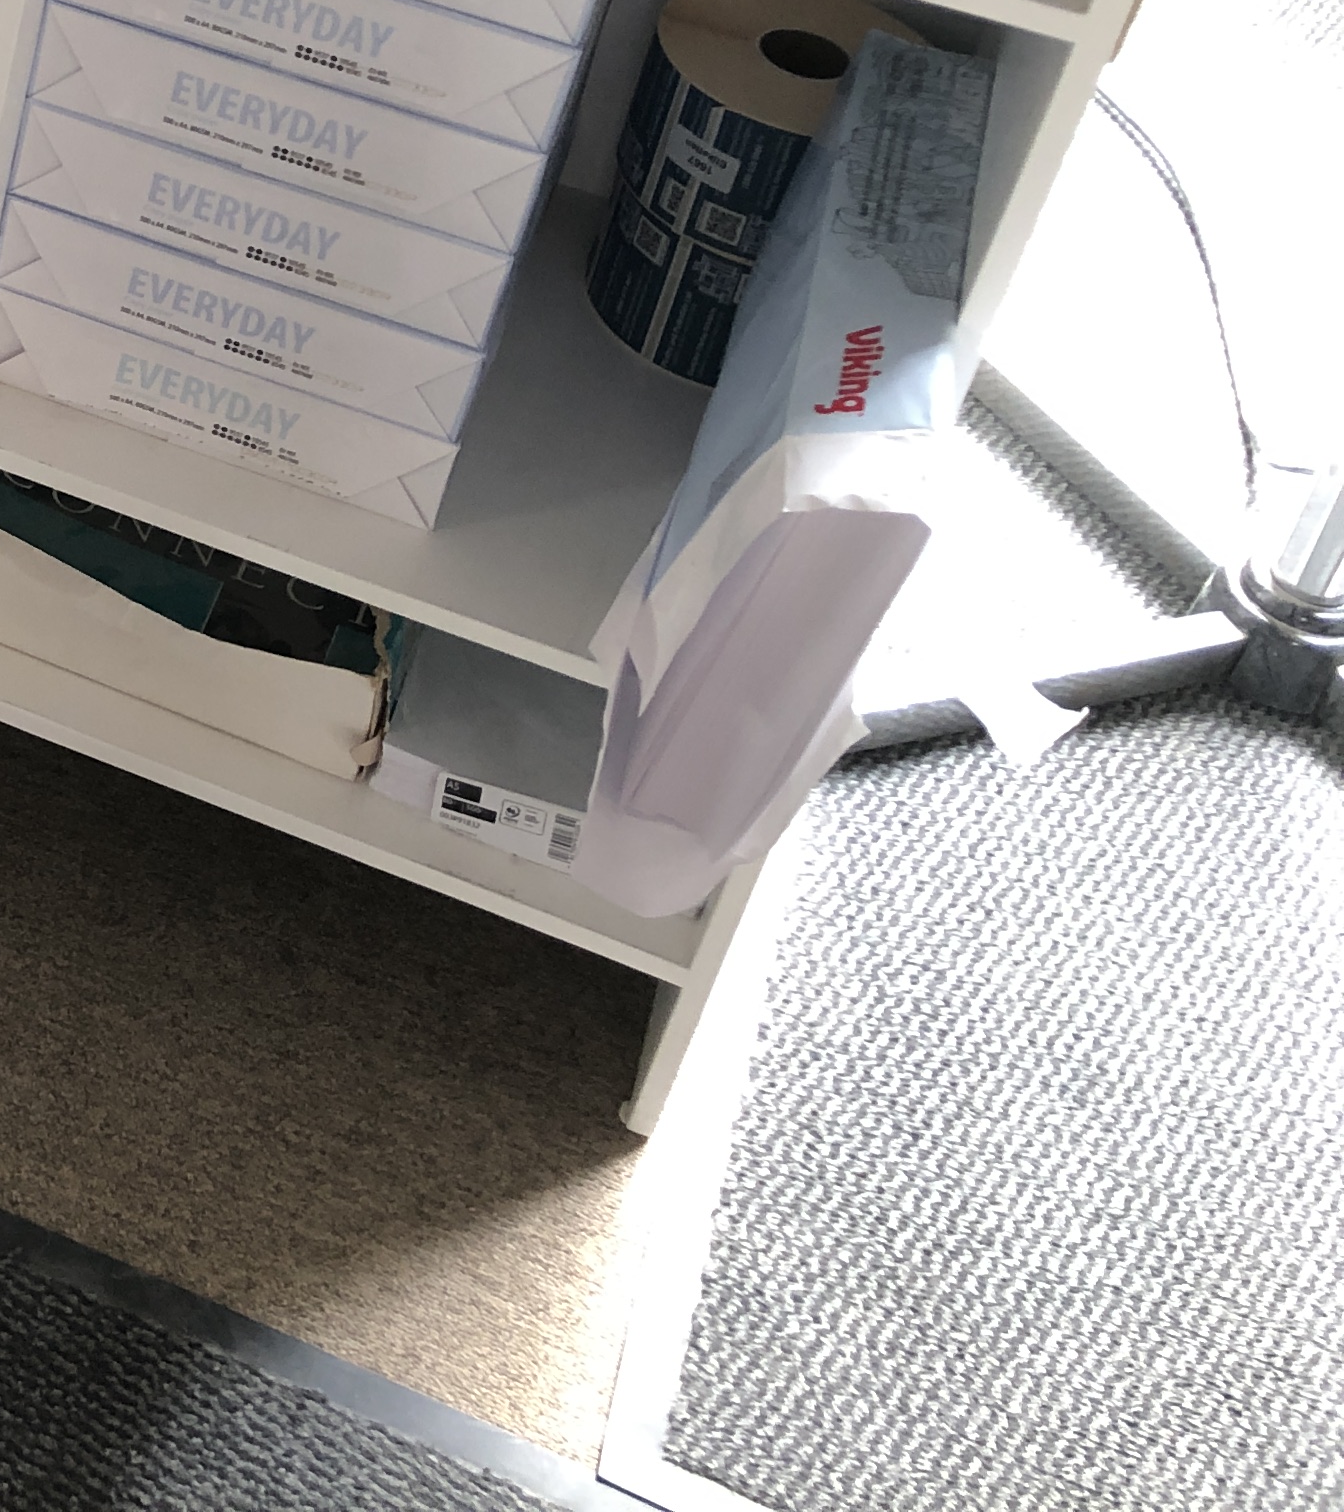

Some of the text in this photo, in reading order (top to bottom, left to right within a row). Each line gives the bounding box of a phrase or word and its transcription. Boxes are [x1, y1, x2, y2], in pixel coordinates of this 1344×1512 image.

[170, 70, 368, 160] EVERYDAY
[148, 171, 341, 260] EVERYDAY
[127, 266, 315, 354] EVERYDAY
[115, 353, 301, 440] EVERYDAY
